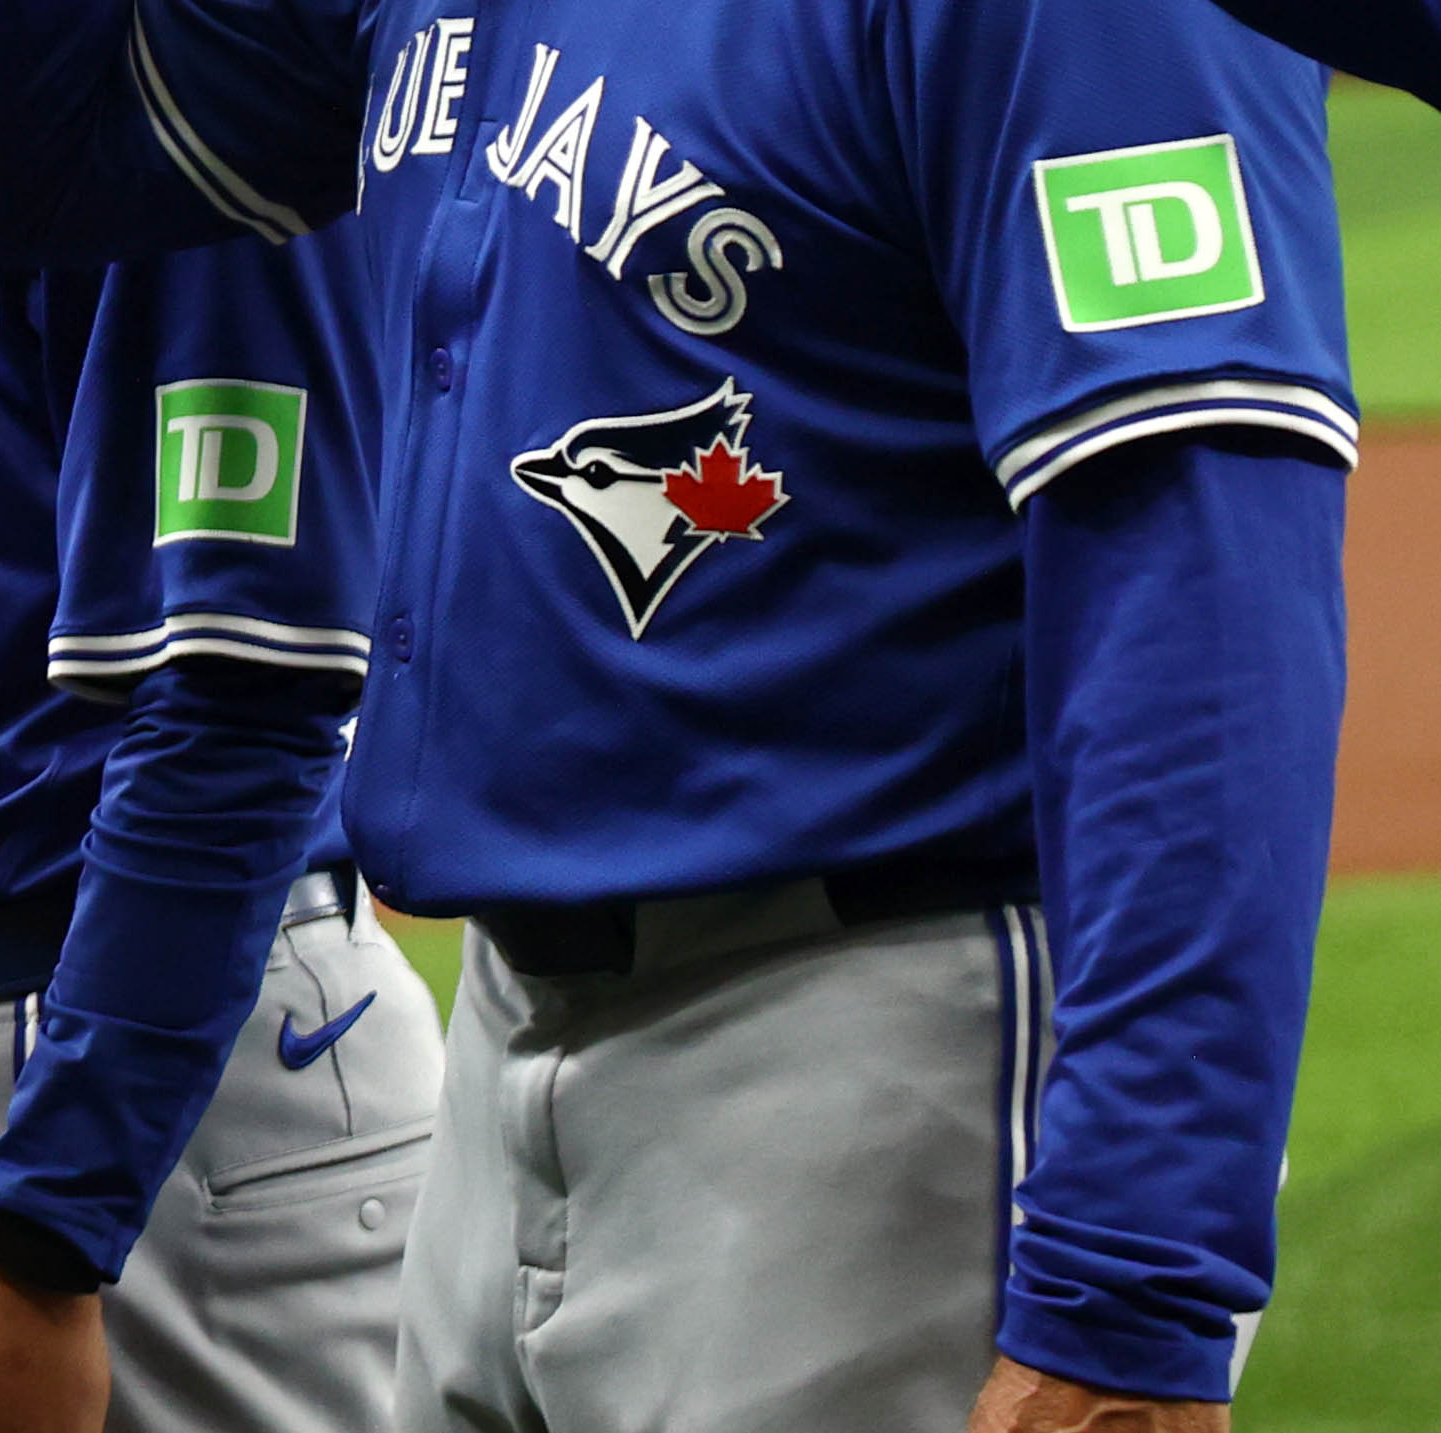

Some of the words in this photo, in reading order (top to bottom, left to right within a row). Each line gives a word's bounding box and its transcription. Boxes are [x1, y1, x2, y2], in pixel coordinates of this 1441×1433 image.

[357, 17, 475, 216] UE
[485, 43, 783, 335] JAYS
[1065, 180, 1224, 287] TD
[166, 413, 280, 503] TD
